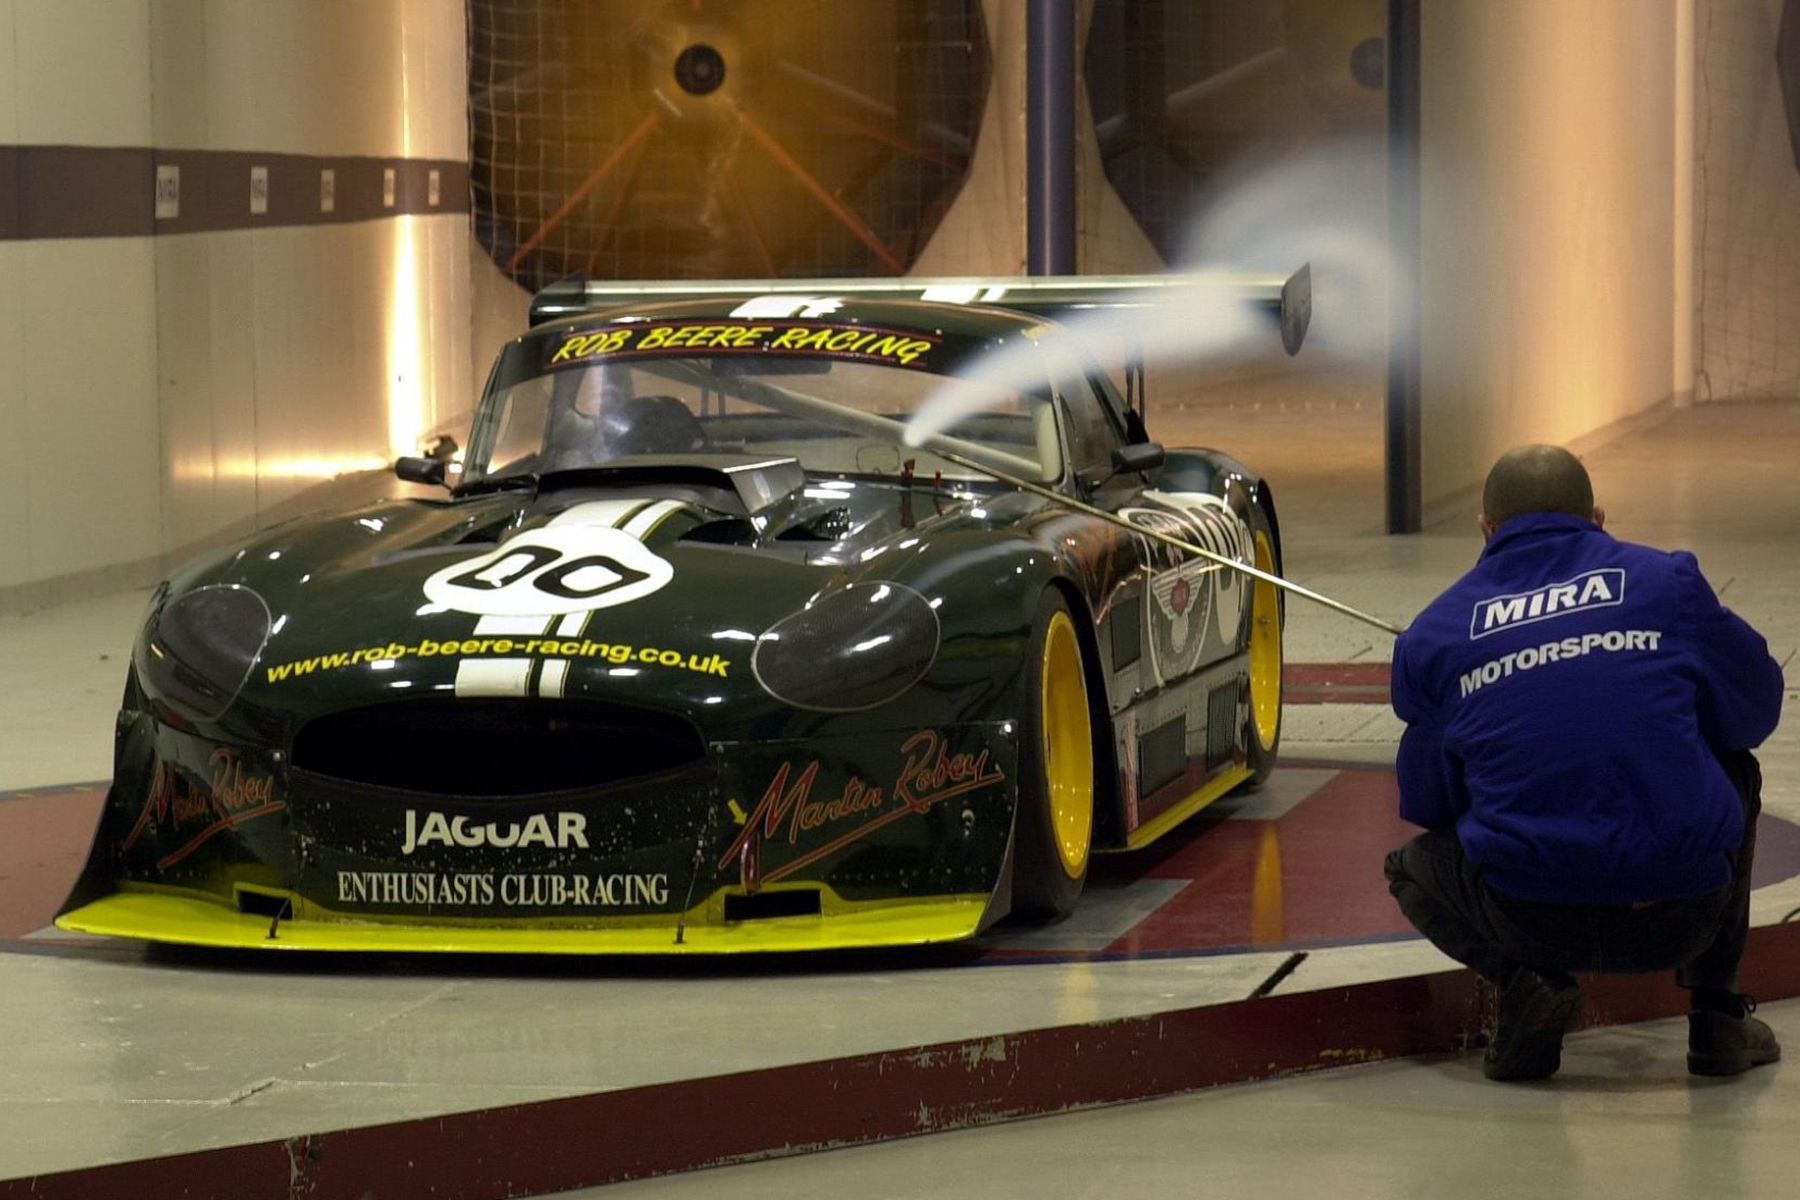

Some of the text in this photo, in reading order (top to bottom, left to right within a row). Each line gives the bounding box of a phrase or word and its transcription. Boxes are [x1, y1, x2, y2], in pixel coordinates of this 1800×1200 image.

[551, 325, 933, 366] ROB BEERE RACING
[1483, 575, 1613, 629] MIRA
[266, 637, 730, 683] www.rob-beere-racing.co.uk
[1459, 630, 1662, 699] MOTORSPORT
[401, 809, 590, 855] JAGUAR
[337, 871, 669, 907] ENTHUSIASTS CLUB-RACING
